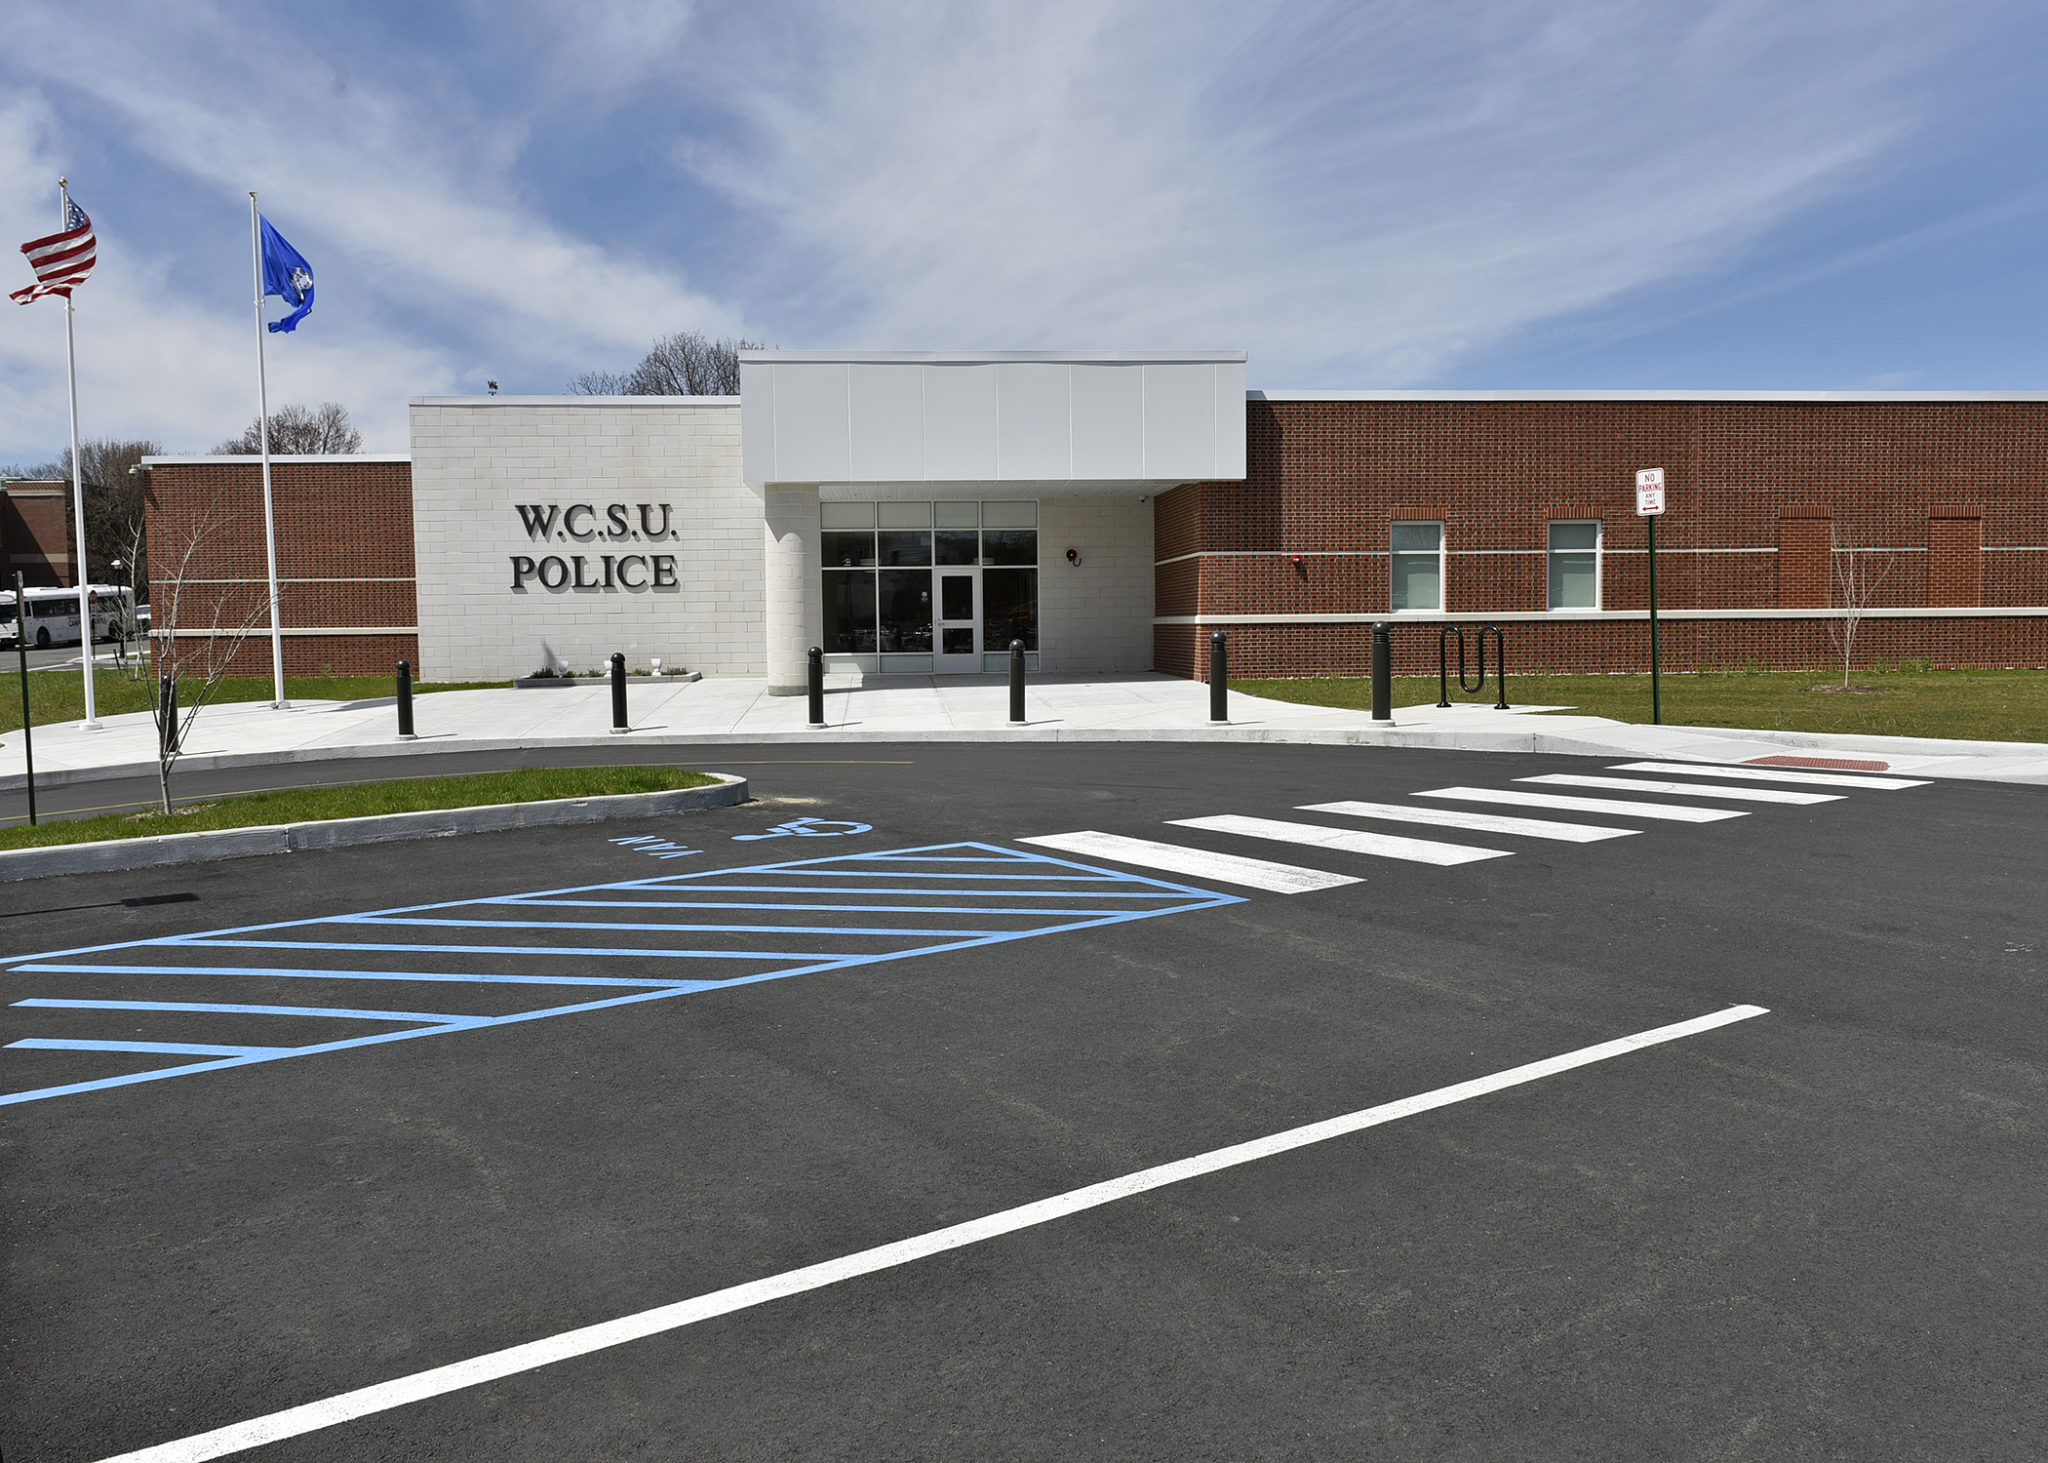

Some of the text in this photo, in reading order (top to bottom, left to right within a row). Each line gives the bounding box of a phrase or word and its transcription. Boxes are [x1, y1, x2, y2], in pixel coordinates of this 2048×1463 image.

[1638, 482, 1662, 492] PARKING
[1644, 473, 1656, 482] NO
[514, 503, 678, 538] W.C.S.U.
[509, 555, 678, 589] POLICE
[607, 835, 704, 859] VAN
